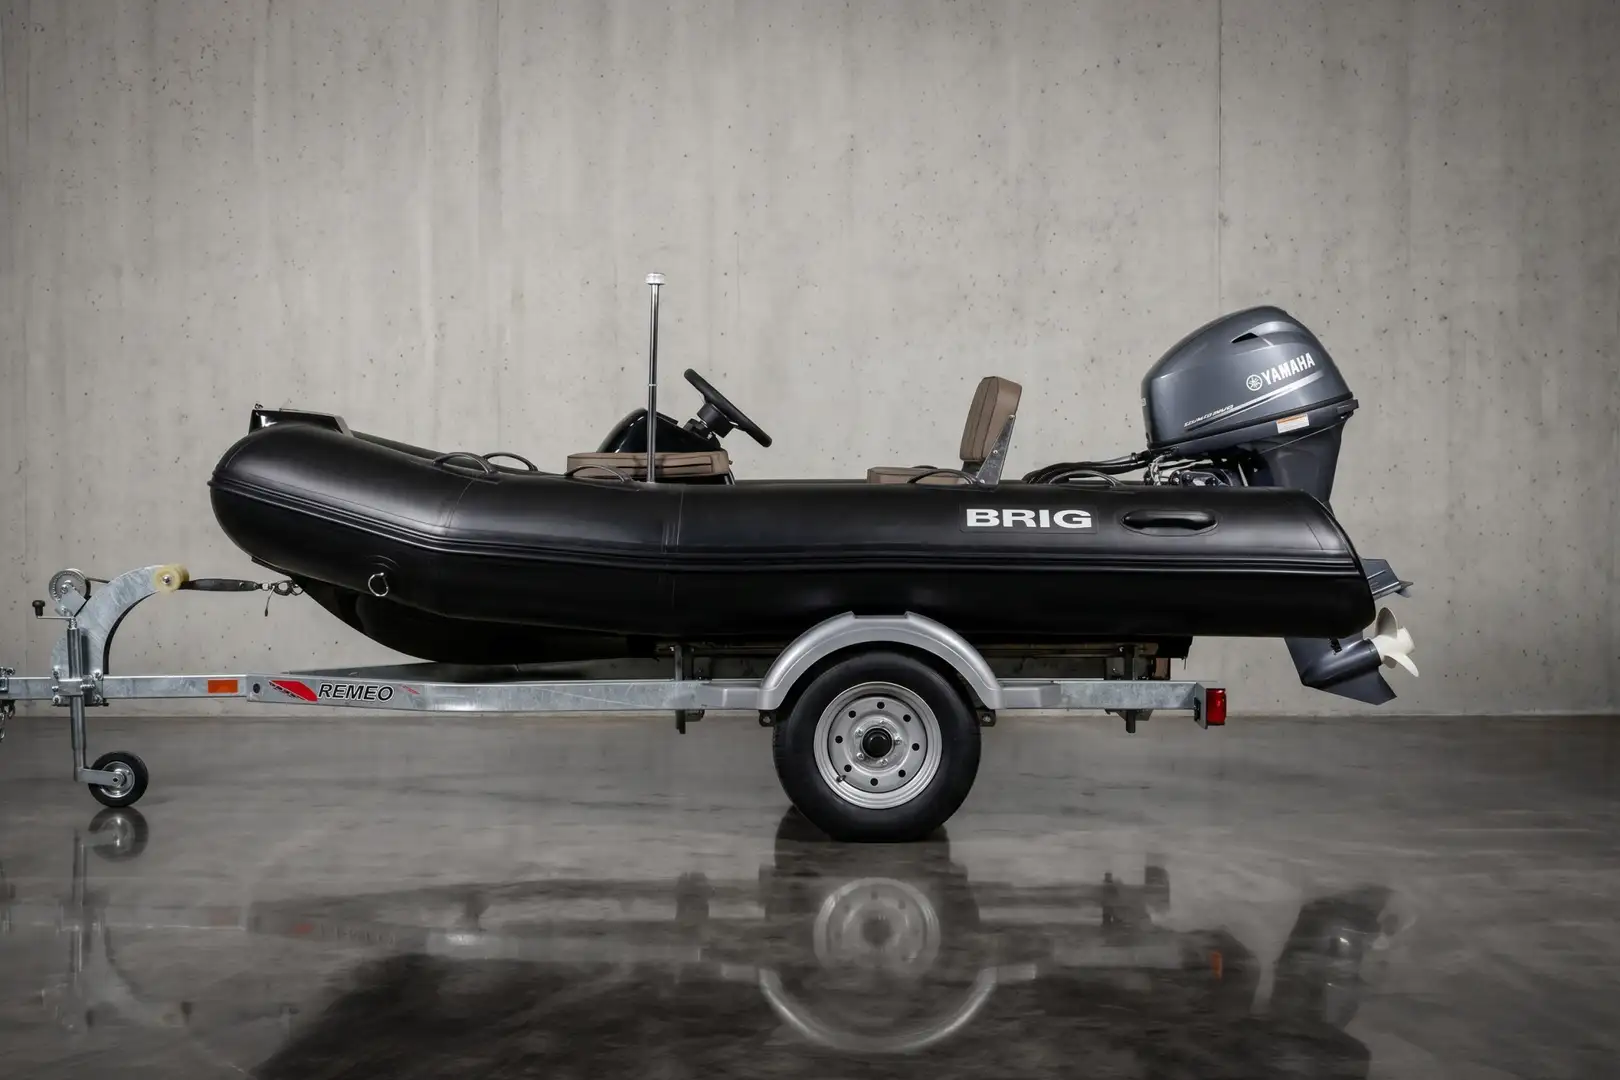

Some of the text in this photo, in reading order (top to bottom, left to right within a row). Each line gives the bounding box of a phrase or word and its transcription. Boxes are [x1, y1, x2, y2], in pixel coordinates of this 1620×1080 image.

[1261, 352, 1316, 385] YAMAHA
[966, 508, 1093, 528] BRIG
[318, 683, 394, 702] REMEO
